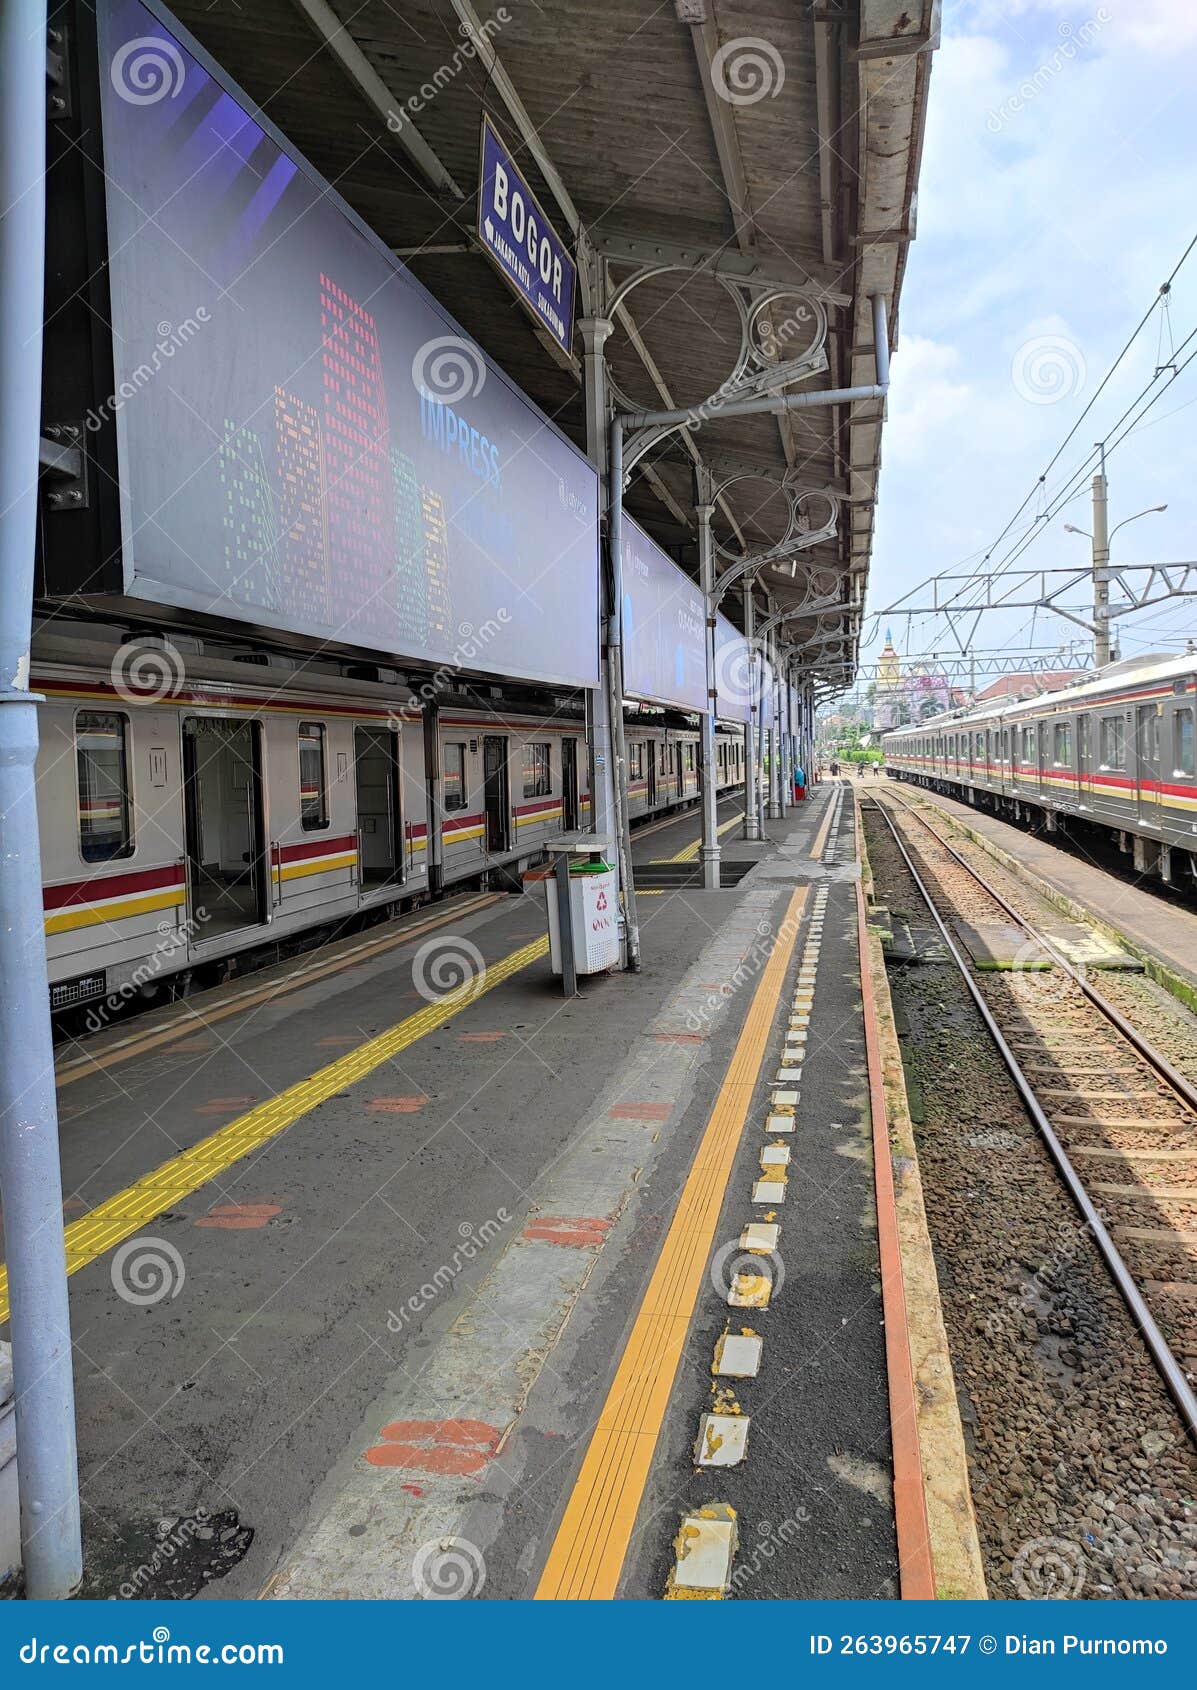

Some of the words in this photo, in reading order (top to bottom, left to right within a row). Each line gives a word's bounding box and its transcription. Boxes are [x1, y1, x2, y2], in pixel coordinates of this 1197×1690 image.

[493, 161, 563, 304] BOGOR
[493, 231, 518, 275] JAKARTA
[420, 385, 501, 490] IMPRESS
